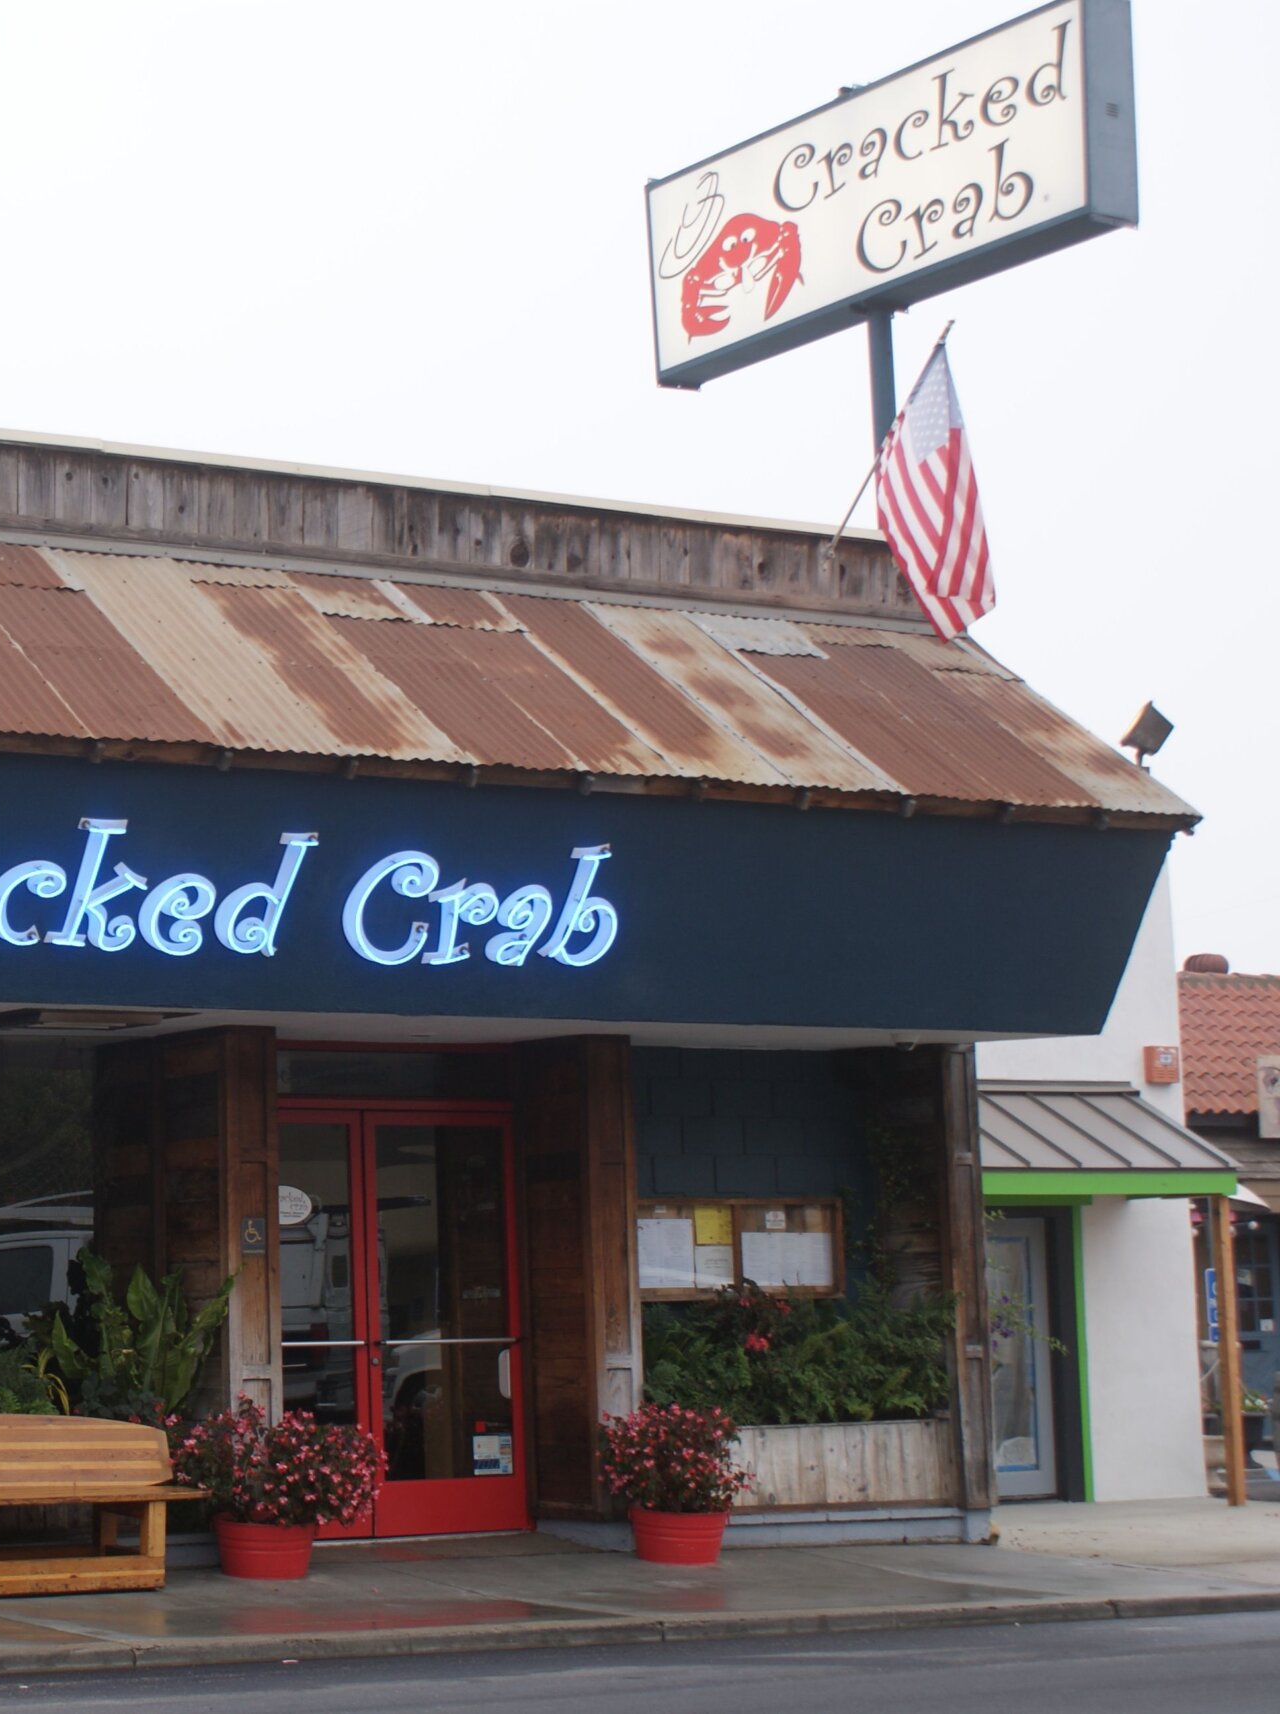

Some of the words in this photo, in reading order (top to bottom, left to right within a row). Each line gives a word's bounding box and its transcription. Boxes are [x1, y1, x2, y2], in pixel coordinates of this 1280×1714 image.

[772, 19, 1073, 213] Cracked
[855, 138, 1035, 275] Crab
[342, 843, 618, 967] Crab
